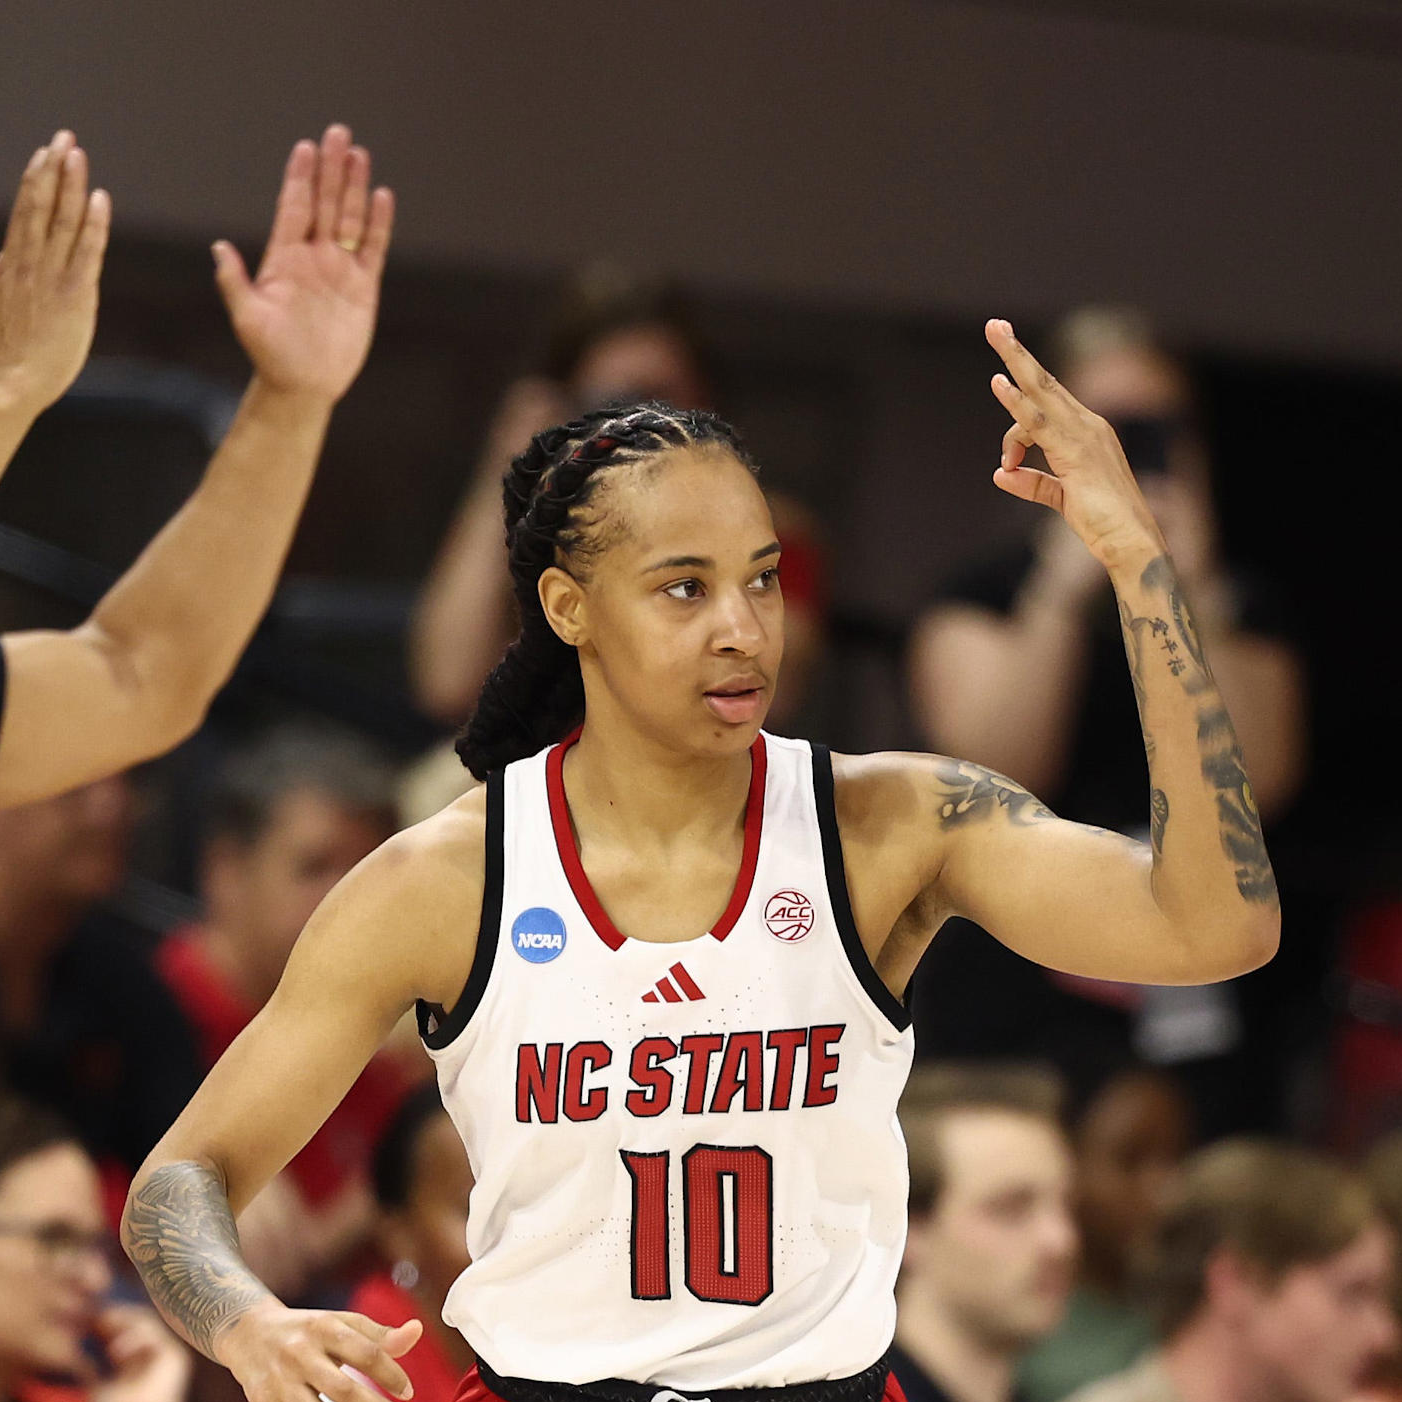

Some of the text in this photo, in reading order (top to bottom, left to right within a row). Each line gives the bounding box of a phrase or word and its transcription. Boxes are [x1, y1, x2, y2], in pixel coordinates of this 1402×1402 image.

[517, 932, 563, 950] NCAA
[770, 906, 812, 919] ACC
[515, 1023, 846, 1124] NC STATE
[619, 1143, 774, 1307] 10
